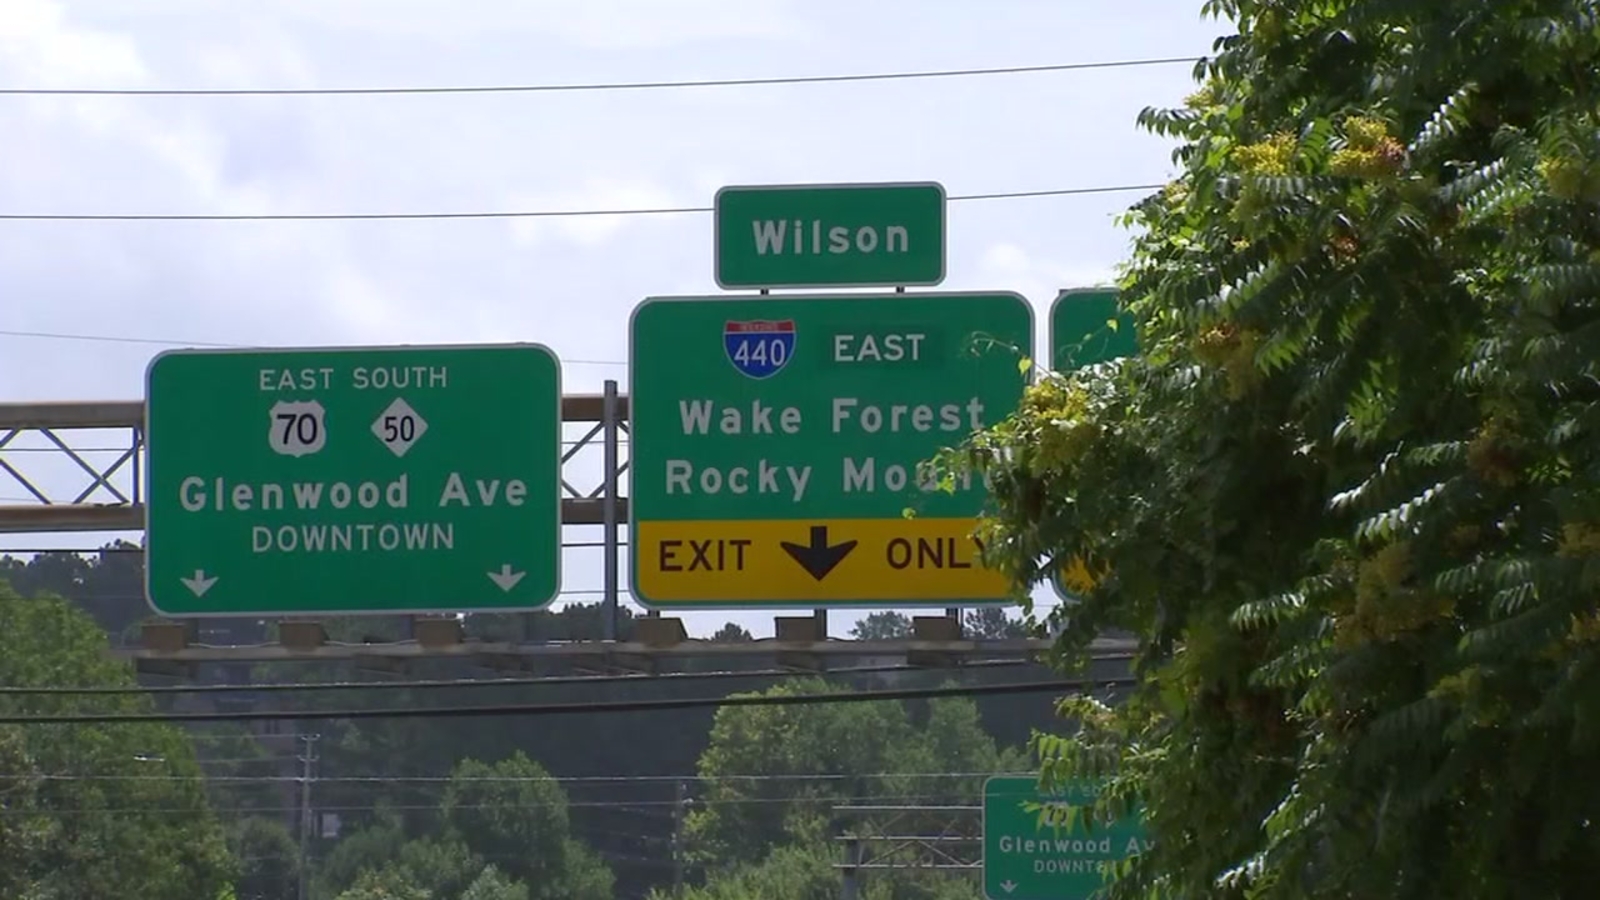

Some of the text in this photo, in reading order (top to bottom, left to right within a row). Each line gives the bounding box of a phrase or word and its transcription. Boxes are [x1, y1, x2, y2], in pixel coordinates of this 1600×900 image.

[752, 219, 909, 254] Wilson
[733, 333, 926, 367] 440 EAST
[259, 366, 447, 391] EAST SOUTH
[275, 413, 416, 445] 70 50
[679, 397, 985, 435] Wake Forest
[179, 472, 528, 512] Glenwood Ave
[666, 457, 995, 502] Rocky Mou
[252, 523, 454, 553] DOWNTOWN
[659, 539, 752, 572] EXIT
[999, 835, 1156, 854] Glenwood Av
[1034, 859, 1117, 874] DOWNT
